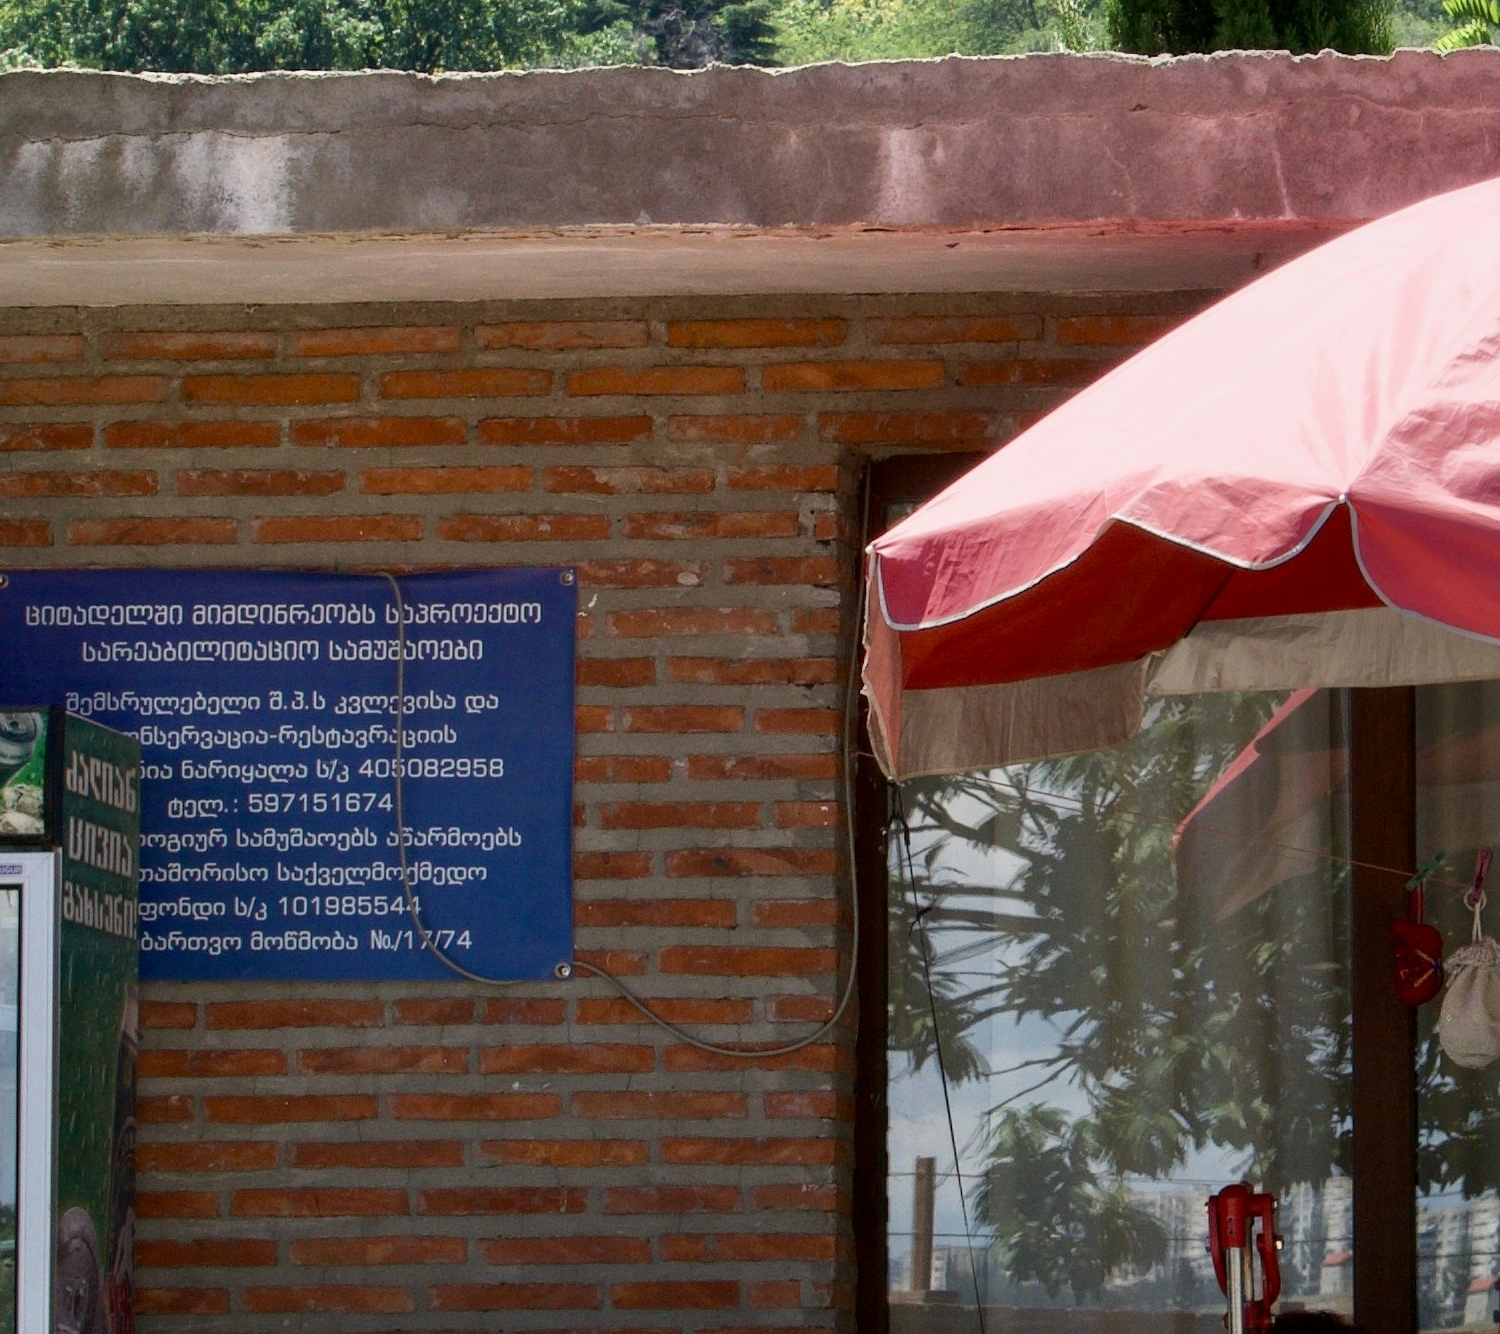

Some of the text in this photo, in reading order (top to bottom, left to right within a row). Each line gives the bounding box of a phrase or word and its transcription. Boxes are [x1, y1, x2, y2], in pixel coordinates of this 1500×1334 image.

[26, 602, 541, 626] ციტადელში მიმდინრეობს საპროექტო
[82, 639, 483, 663] სარეაბილიტაციო სამუშაოები
[66, 691, 261, 716] შემსრულებელი
[465, 695, 499, 715] და
[123, 724, 457, 749] ნსერვაცია-რესტავრაციის
[181, 760, 308, 784] ნარიყალა
[358, 759, 505, 779] 405082958
[248, 793, 394, 813] 597151674
[236, 828, 377, 851] სამუშაოებს
[278, 896, 422, 916] 101985544
[251, 931, 358, 951] მოწმობა
